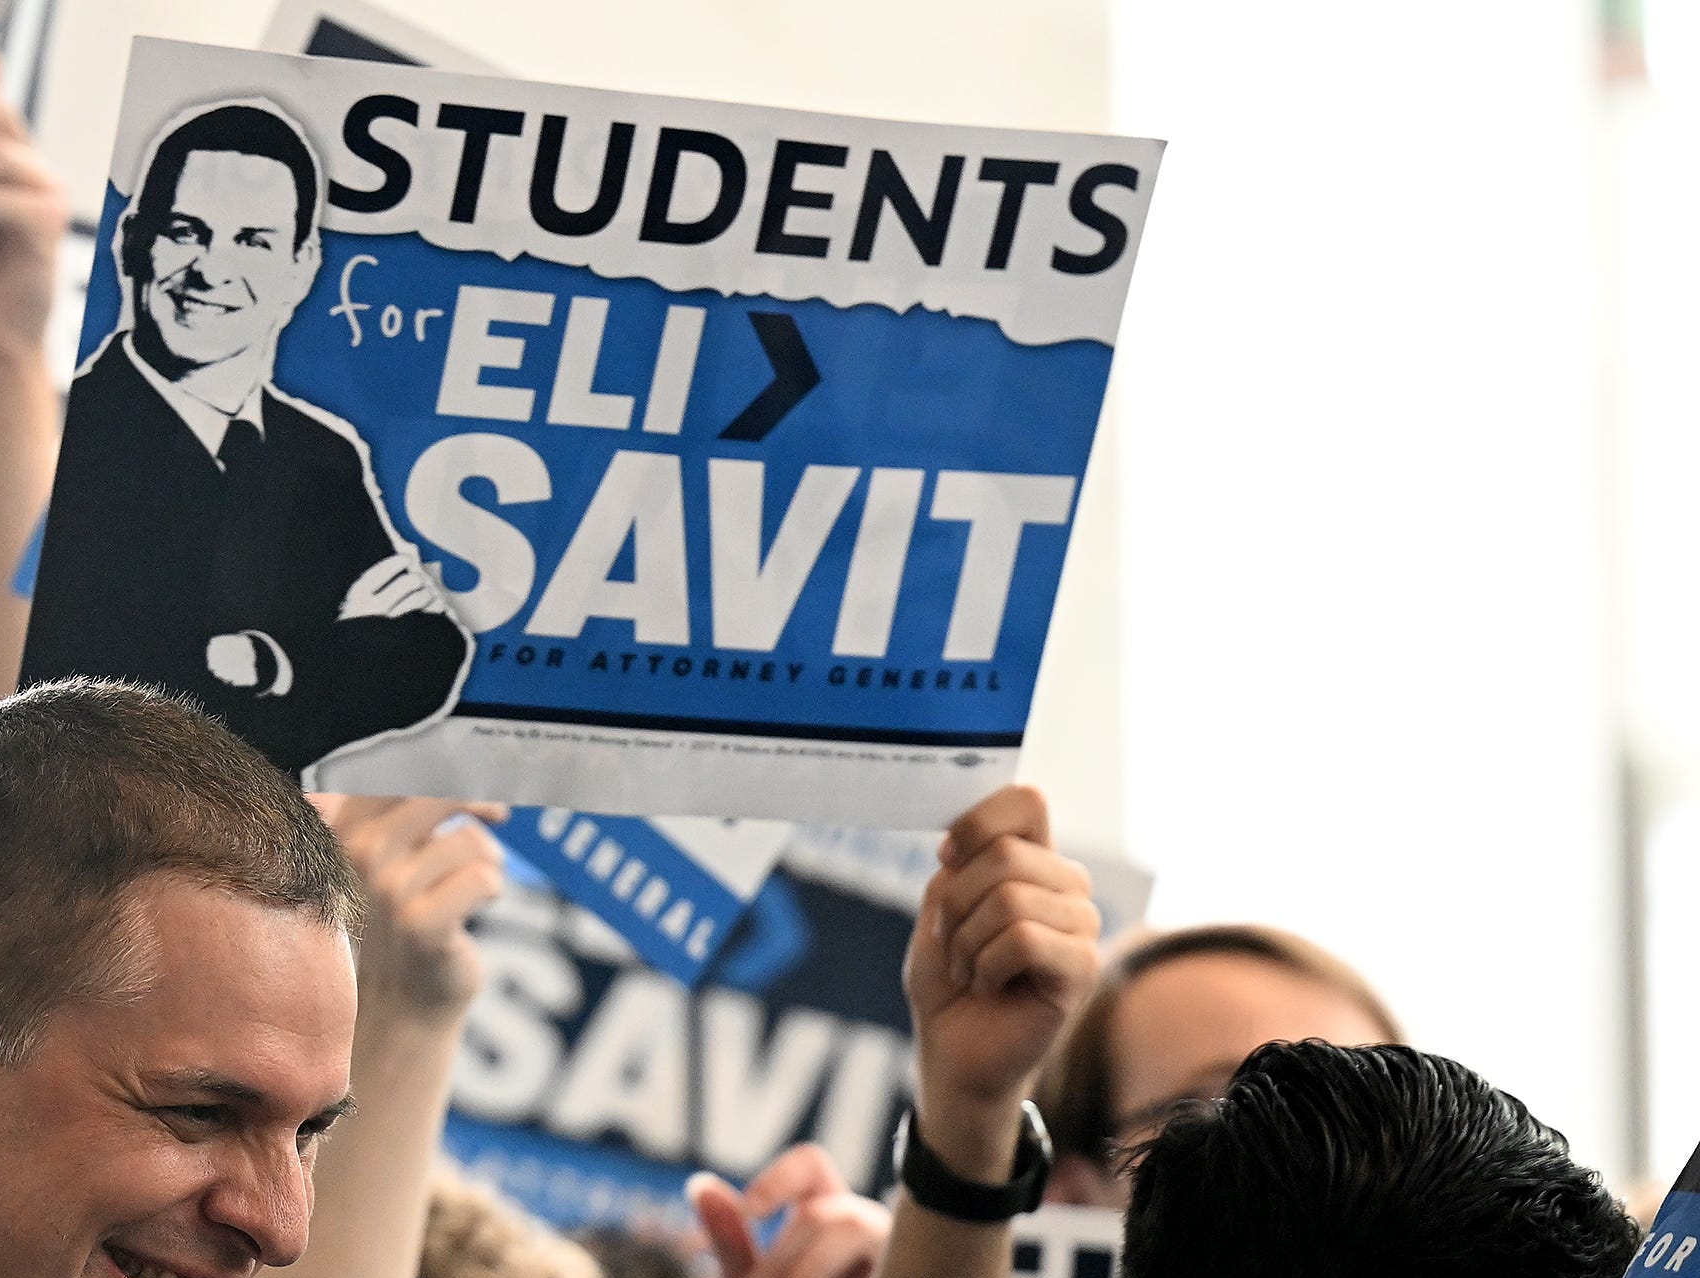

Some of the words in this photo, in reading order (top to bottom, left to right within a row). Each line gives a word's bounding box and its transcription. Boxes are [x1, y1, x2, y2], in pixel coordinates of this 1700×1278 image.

[326, 93, 1140, 277] STUDENTS
[329, 254, 445, 348] for
[435, 284, 708, 435] ELI
[405, 431, 1078, 662] SAVIT
[487, 643, 565, 668] FOR
[588, 651, 807, 685] ATTORNEY
[826, 663, 1003, 694] GENERAL
[448, 940, 916, 1195] SAVI
